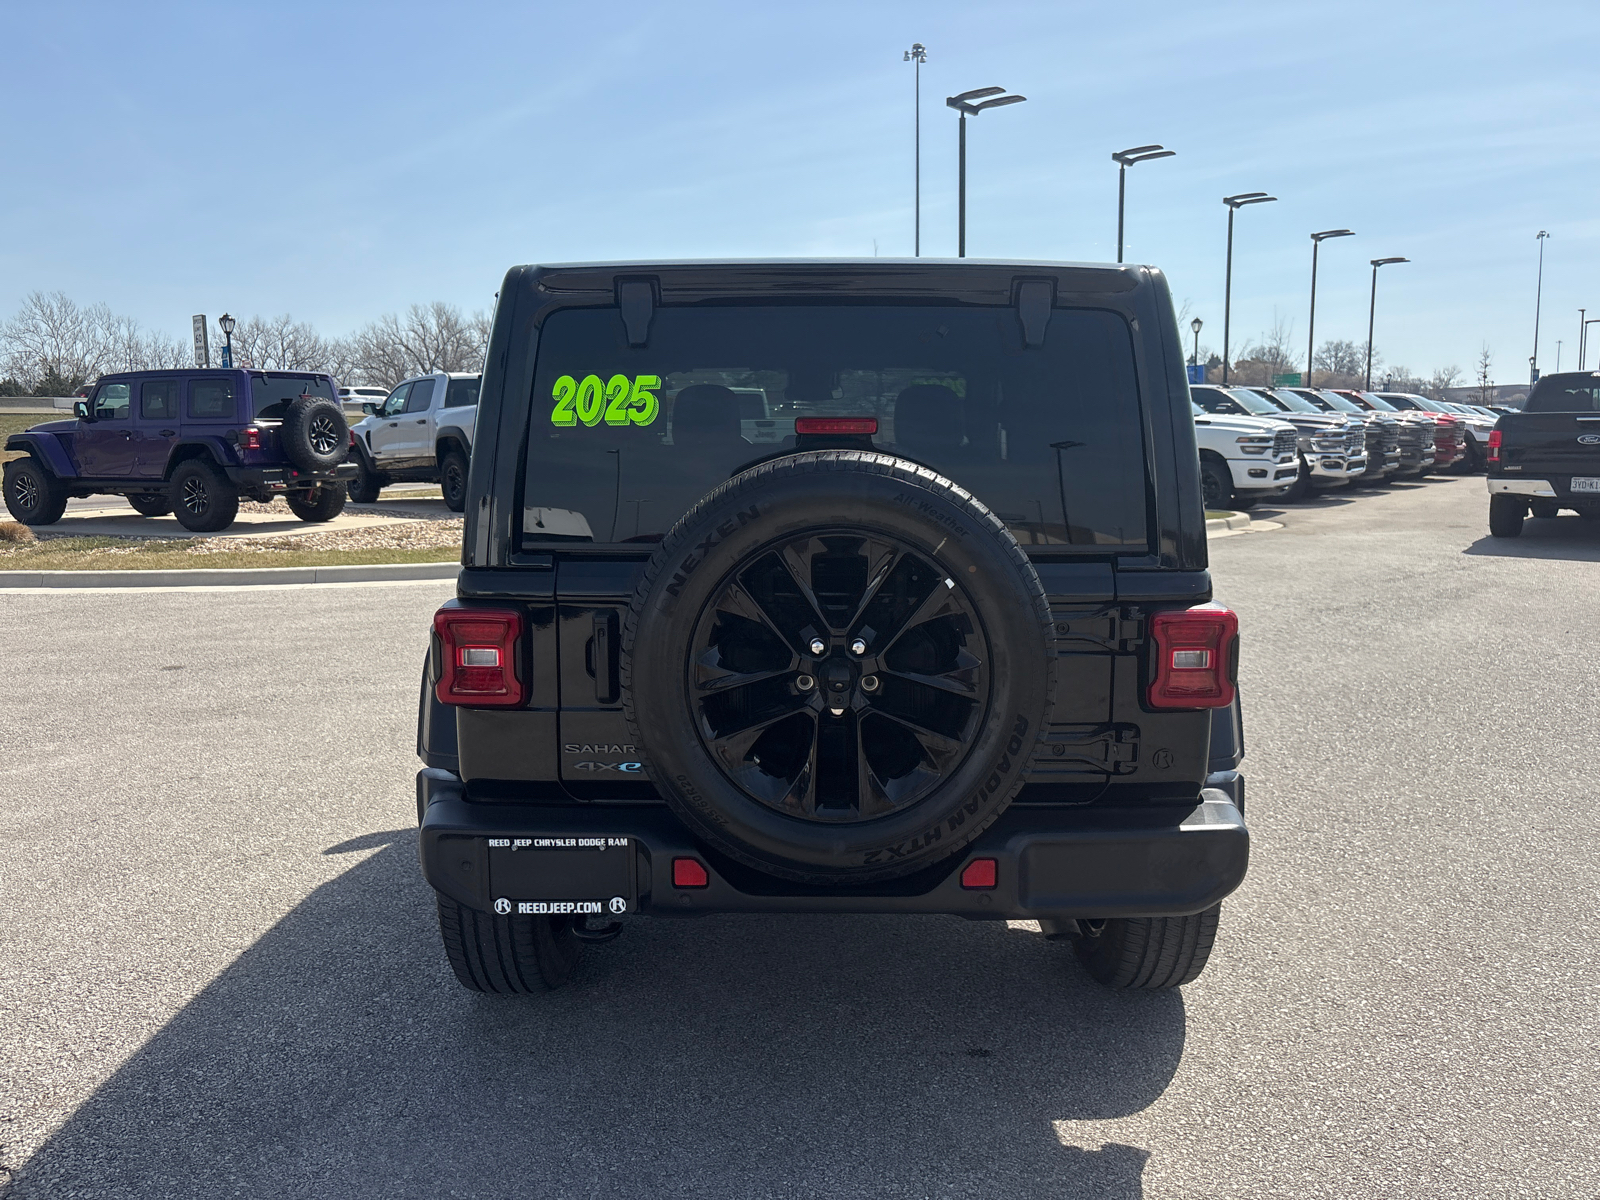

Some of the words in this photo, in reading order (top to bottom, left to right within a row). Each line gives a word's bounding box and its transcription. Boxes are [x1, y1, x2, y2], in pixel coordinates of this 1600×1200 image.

[551, 374, 661, 427] 2025
[893, 494, 970, 537] All-Weather
[665, 505, 760, 597] NEXEN
[565, 744, 636, 754] SAHAR
[947, 714, 1029, 831] ROADIAN
[676, 774, 729, 826] 255/60R20
[488, 838, 510, 847] REED
[512, 838, 532, 847] JEEP
[534, 838, 576, 847] CHRYSLER
[578, 838, 606, 847] DODGE
[608, 838, 628, 846] RAM
[864, 825, 942, 864] HTX2
[518, 902, 602, 914] REEDJEEP.COM
